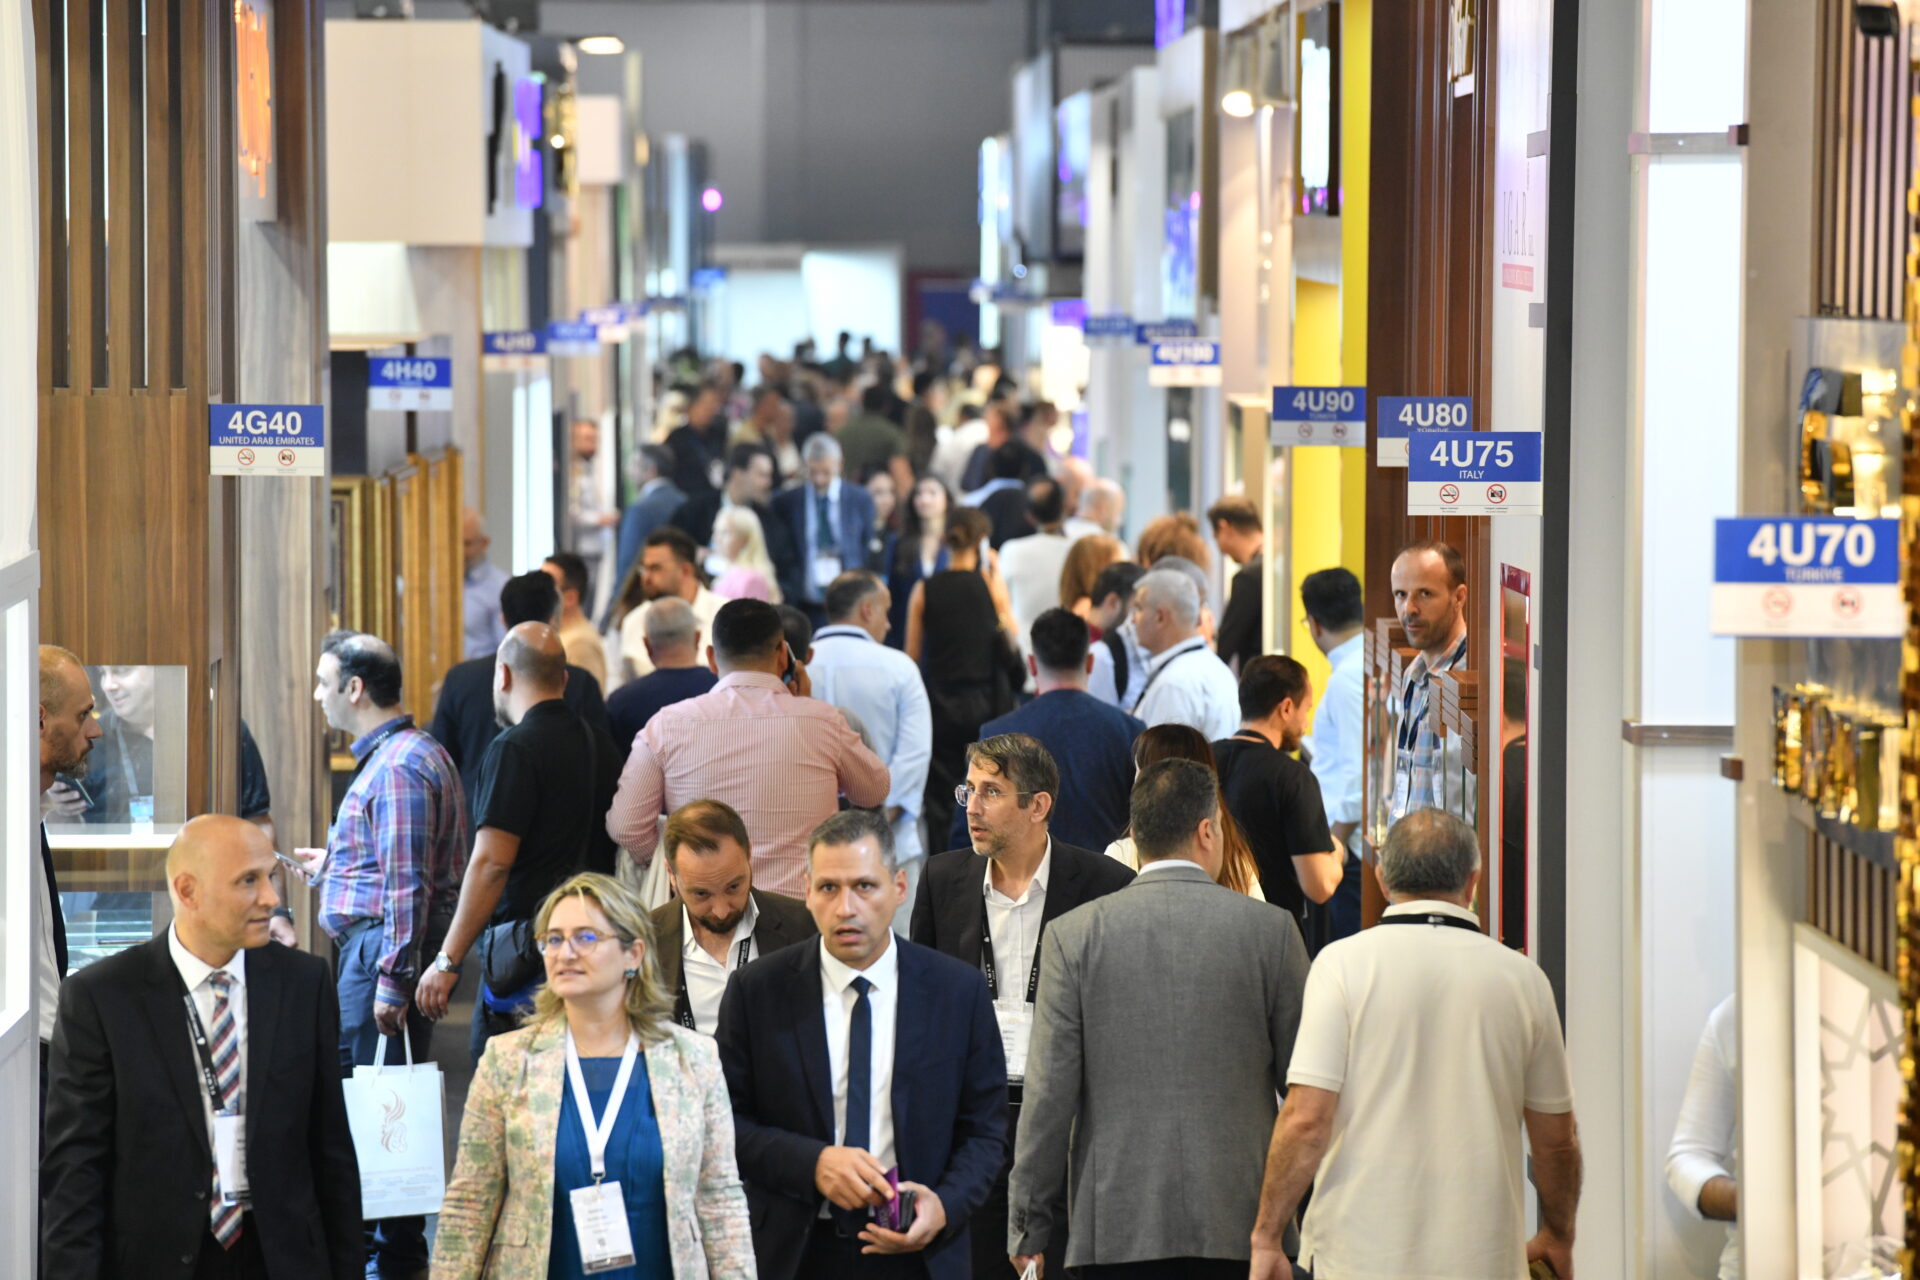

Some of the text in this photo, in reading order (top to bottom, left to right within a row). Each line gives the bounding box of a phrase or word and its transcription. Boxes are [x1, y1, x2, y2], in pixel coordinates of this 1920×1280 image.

[381, 361, 437, 381] 4H40
[1293, 391, 1355, 412] 4U90
[228, 410, 302, 435] 4G40
[1398, 403, 1468, 427] 4U80
[218, 436, 315, 446] UNITED ARAB EMIRATES
[1430, 440, 1514, 468] 4U75
[1459, 470, 1484, 479] ITALY
[1747, 522, 1876, 567] 4U70
